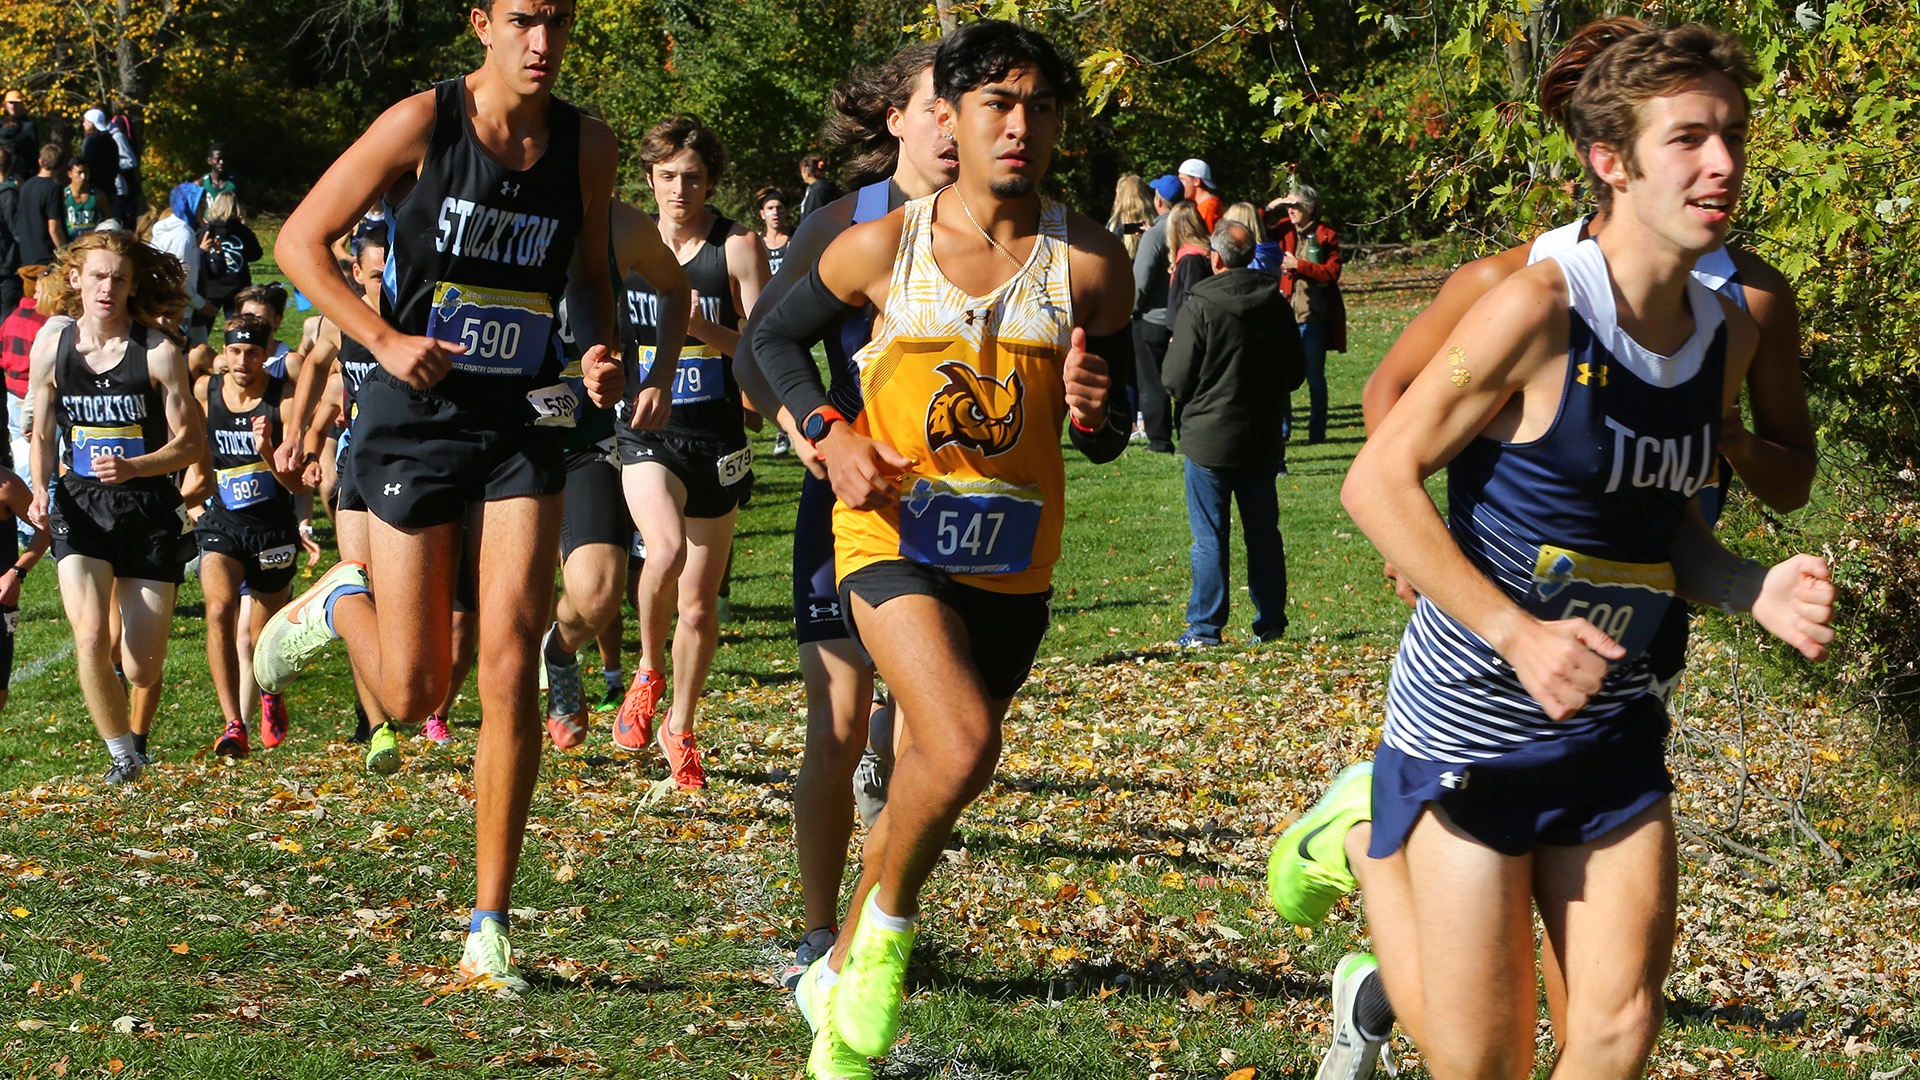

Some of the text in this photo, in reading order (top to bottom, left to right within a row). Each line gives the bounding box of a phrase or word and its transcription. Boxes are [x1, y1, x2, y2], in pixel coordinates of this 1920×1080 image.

[435, 196, 559, 267] STOCKTON
[459, 317, 521, 359] 590
[464, 364, 486, 373] COUNTRY
[487, 367, 523, 375] CHAMPIONSHIPS
[674, 366, 702, 394] 79
[62, 394, 147, 422] STOCKTON
[543, 394, 576, 418] 590
[215, 430, 259, 456] STOCKT
[1604, 415, 1711, 498] TCNJ
[726, 449, 751, 477] 579
[232, 479, 261, 501] 592
[936, 510, 1005, 556] 547
[267, 551, 291, 565] 592
